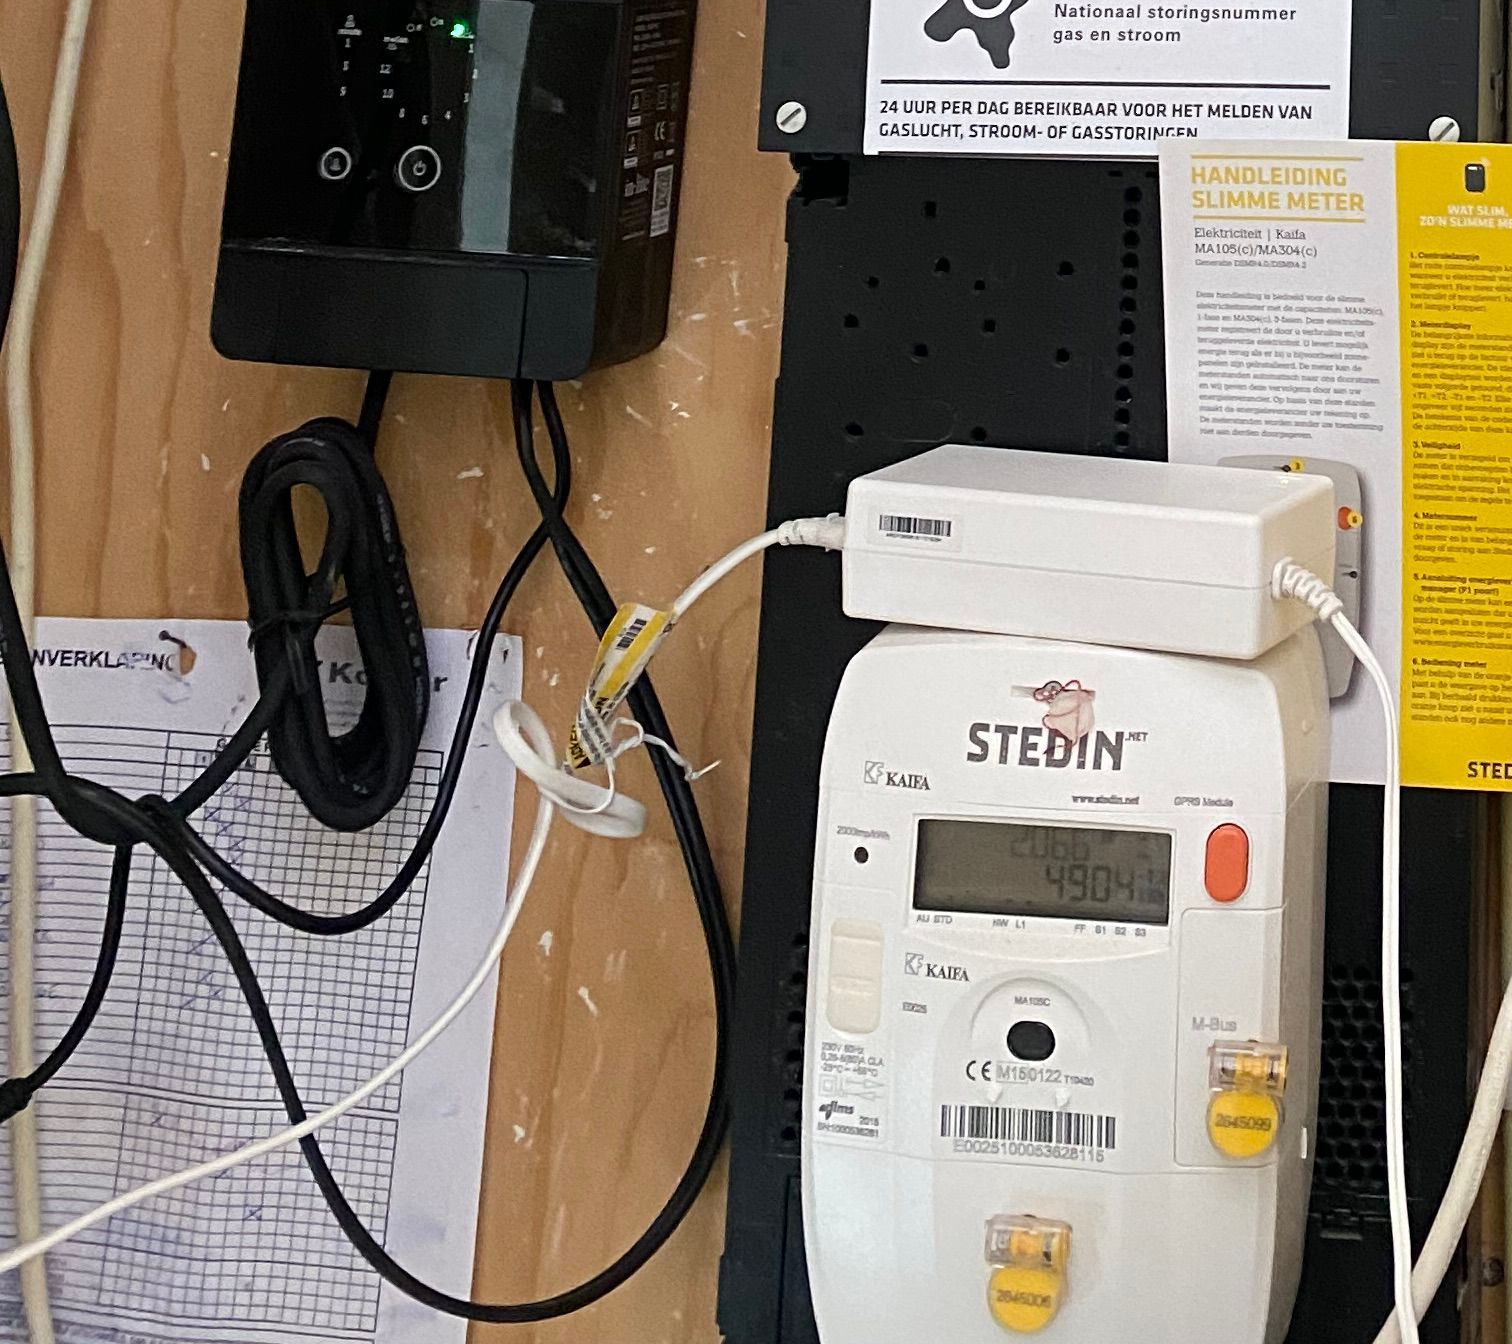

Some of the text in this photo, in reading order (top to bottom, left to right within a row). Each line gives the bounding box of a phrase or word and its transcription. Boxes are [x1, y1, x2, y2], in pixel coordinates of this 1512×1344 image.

[1054, 4, 1296, 22] Nationaal storingsnummer
[1053, 28, 1181, 43] gas en stroom
[880, 100, 1312, 120] 24 UUR PER DAG BEREIKBAAR VOOR HET MELDEN VAN
[879, 123, 964, 141] GASLUCHT,
[969, 124, 1043, 140] STROOM-
[1048, 125, 1067, 139] OF
[1191, 166, 1346, 186] HANDLEIDING
[1192, 191, 1365, 211] SLIMME METER
[1447, 205, 1473, 215] WAT
[1449, 217, 1495, 228] SLIMME
[1195, 228, 1306, 240] Elektriciteit Kaifa
[1195, 243, 1317, 257] MA105(c)/MA304(c)
[967, 722, 1124, 771] STEDIN
[886, 771, 931, 791] KAIFA
[926, 963, 970, 982] KAIFA
[1192, 1017, 1237, 1032] M-Bus
